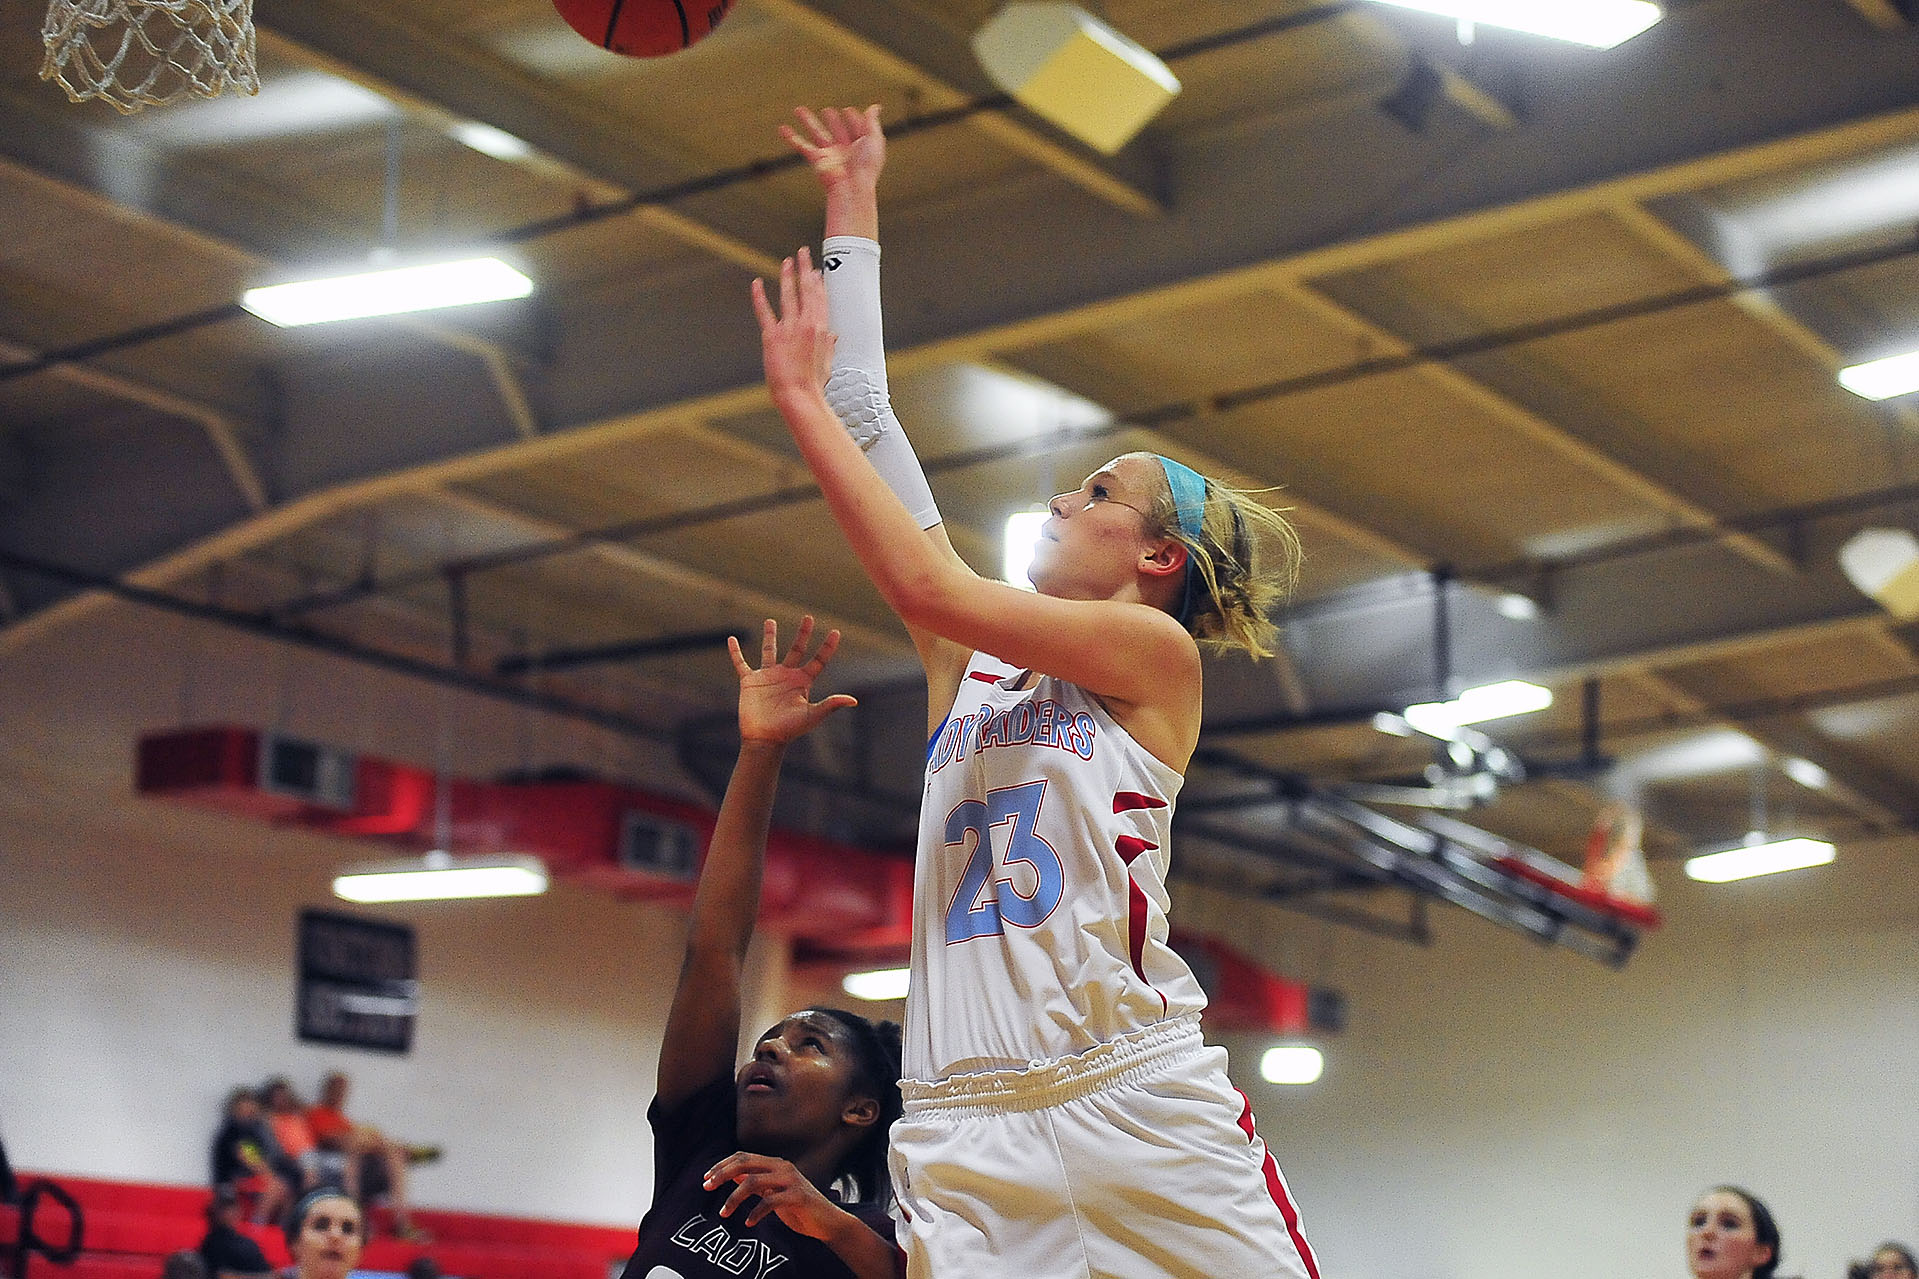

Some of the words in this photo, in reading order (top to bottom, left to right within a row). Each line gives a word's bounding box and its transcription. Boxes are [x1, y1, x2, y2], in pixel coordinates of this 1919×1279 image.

[975, 699, 1095, 761] RAIDERS
[944, 779, 1065, 946] 23
[670, 1214, 789, 1279] LADY
